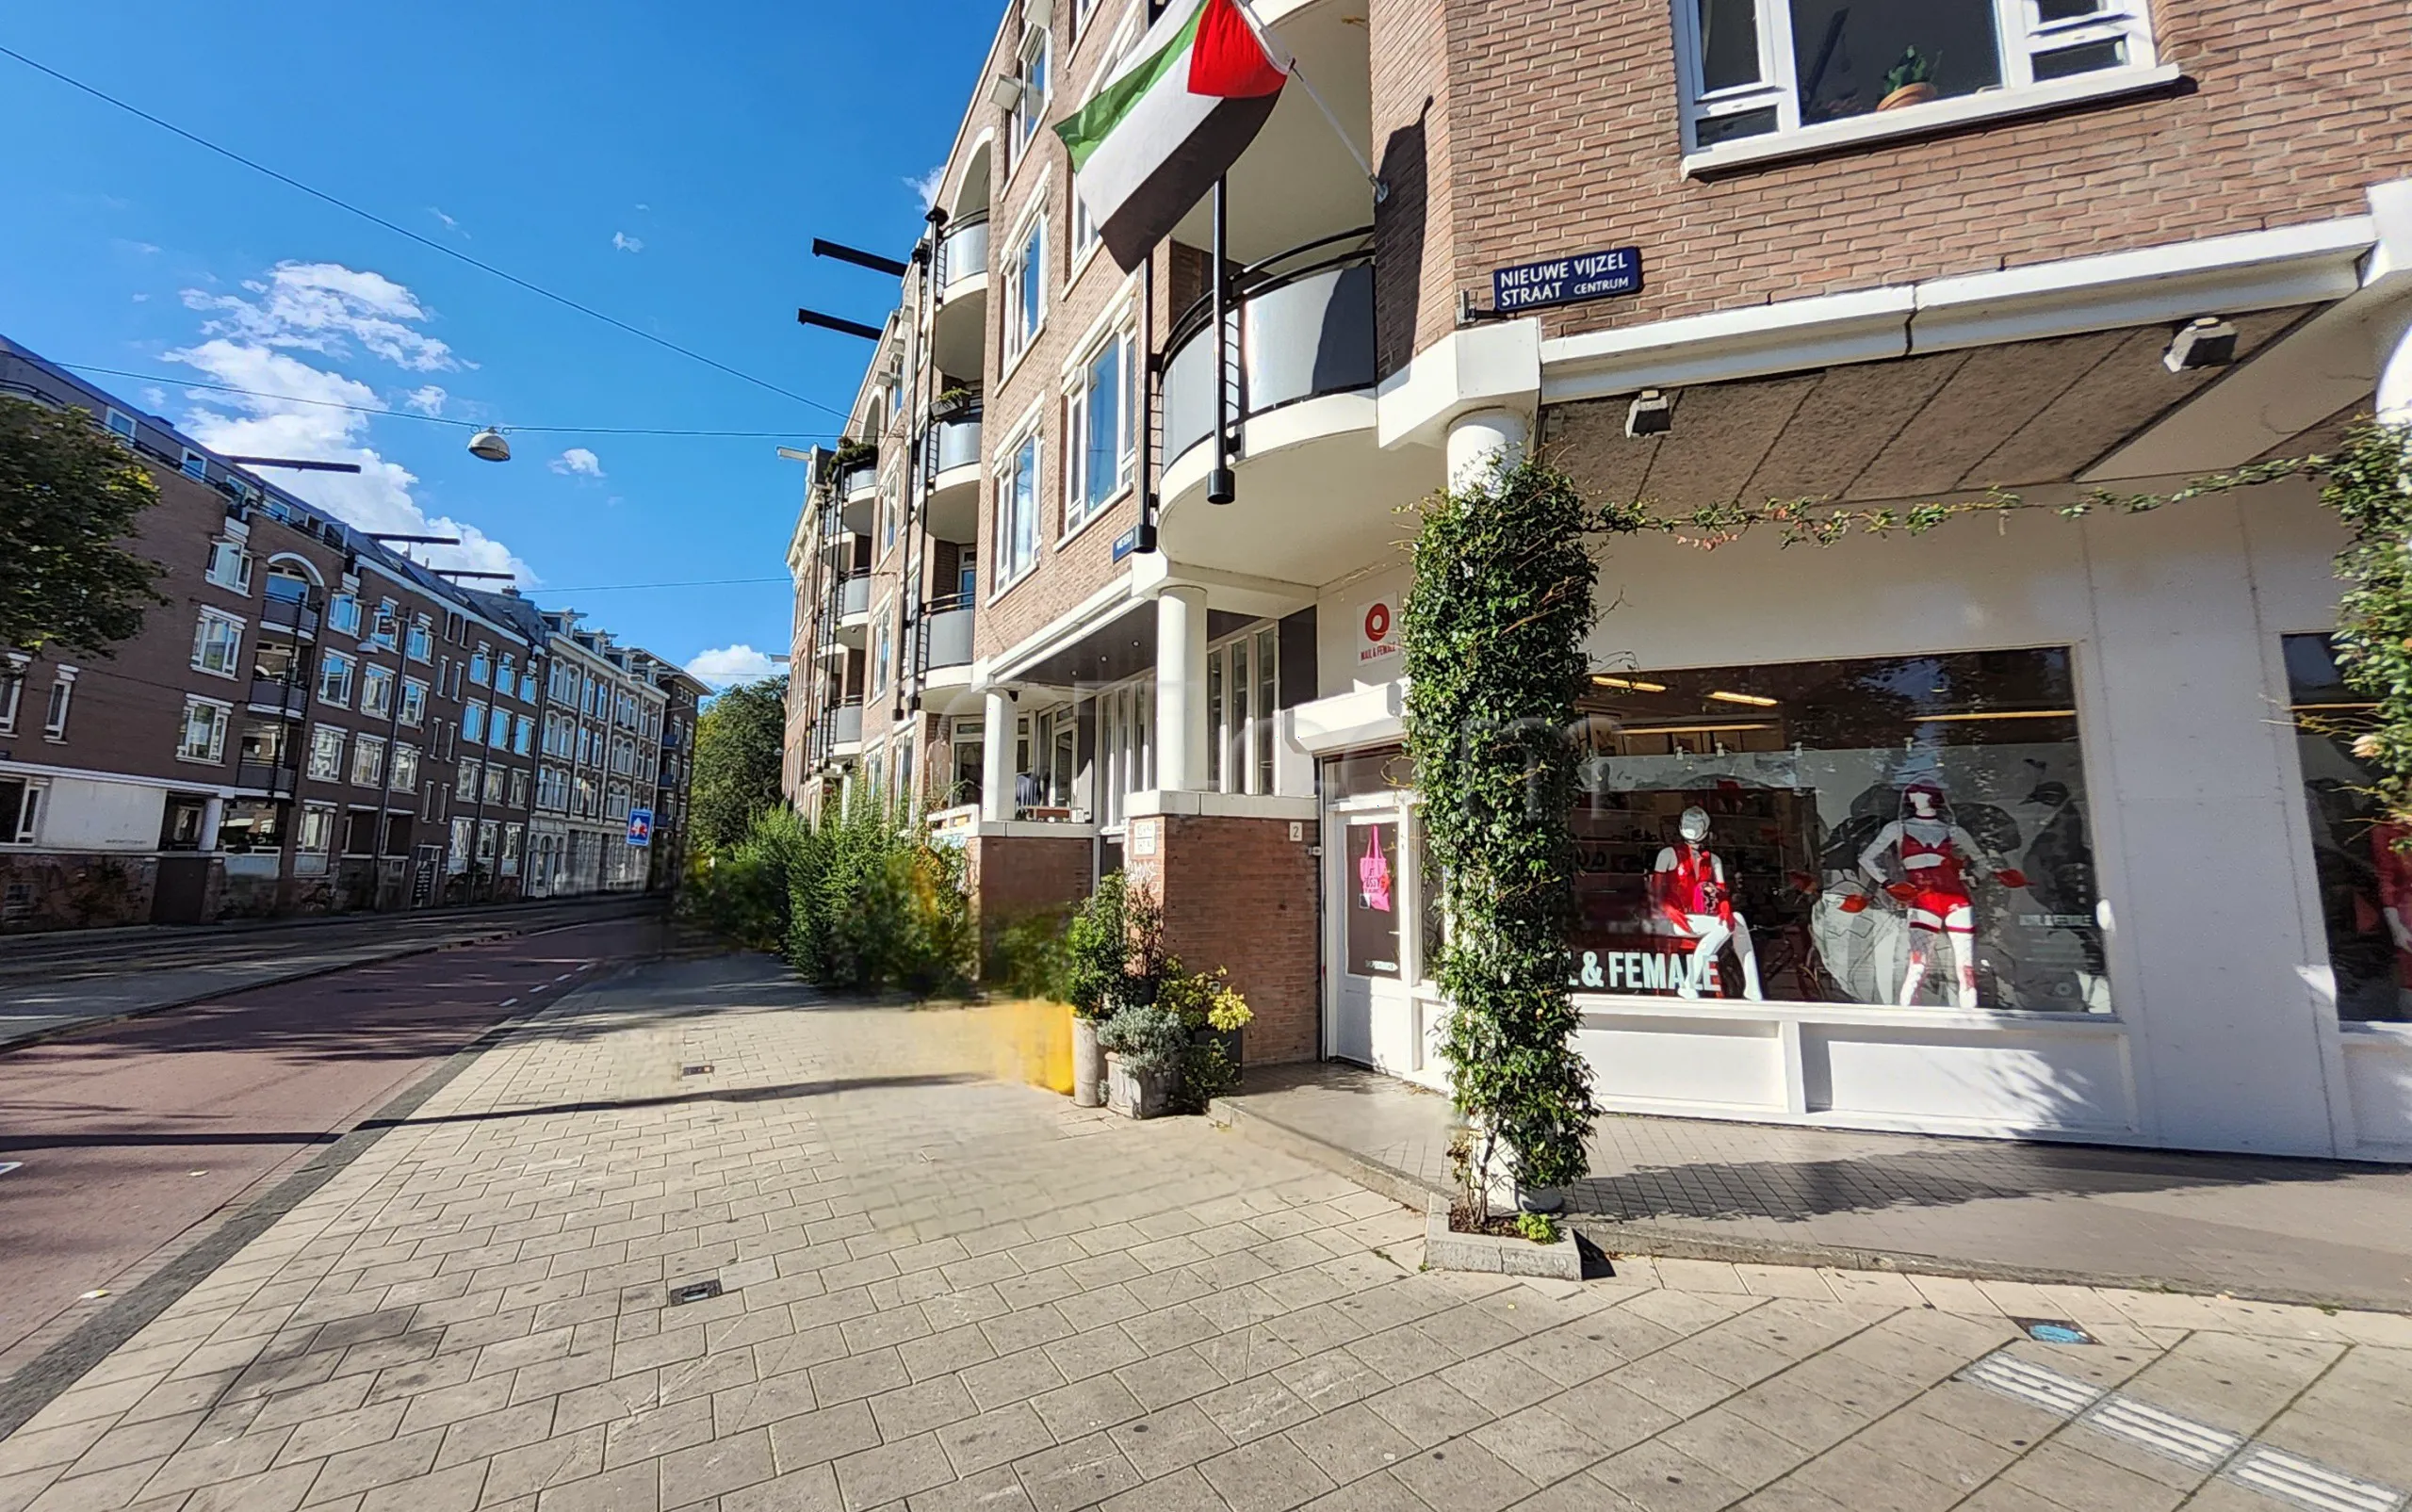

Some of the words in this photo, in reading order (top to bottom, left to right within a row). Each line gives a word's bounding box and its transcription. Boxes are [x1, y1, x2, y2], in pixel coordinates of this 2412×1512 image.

[1501, 260, 1570, 288] NIEUWE
[1573, 252, 1628, 278] VIJZEL
[1501, 282, 1563, 306] STRAAT
[1573, 277, 1629, 296] CENTRUM
[1293, 826, 1299, 838] 2
[1581, 951, 1604, 987] &
